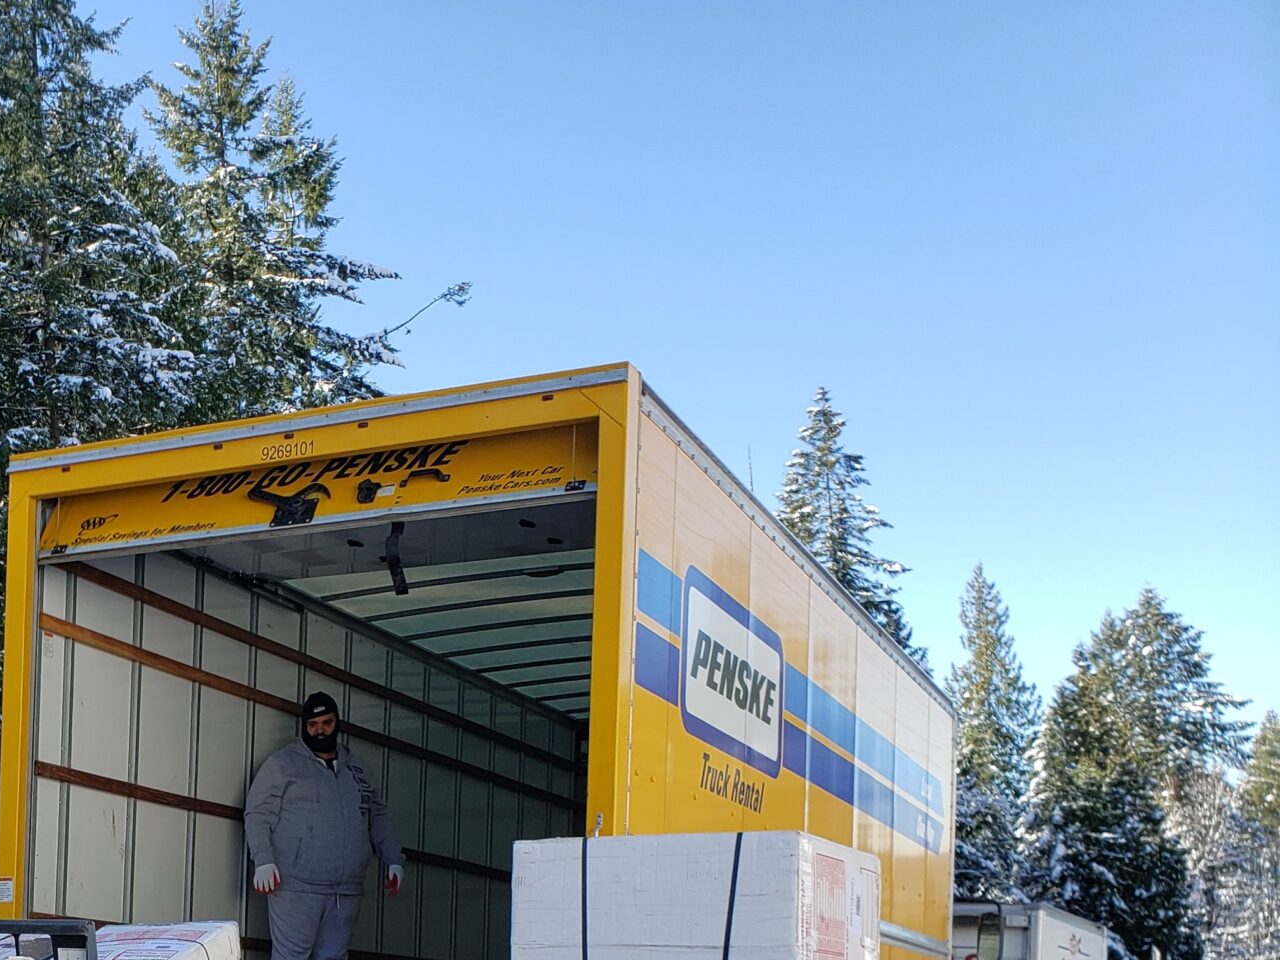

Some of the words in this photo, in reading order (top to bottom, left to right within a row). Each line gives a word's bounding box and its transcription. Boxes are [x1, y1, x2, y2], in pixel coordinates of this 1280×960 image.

[161, 440, 470, 503] 1-800-GO-PENSKE
[260, 440, 315, 461] 9269101
[478, 473, 505, 482] Your
[506, 469, 539, 479] Next
[541, 465, 564, 475] Car
[72, 534, 109, 546] Special
[111, 531, 148, 541] Savings
[151, 528, 168, 536] for
[169, 522, 216, 533] Members
[690, 629, 776, 726] PENSKE
[700, 753, 730, 802] Truck
[731, 767, 764, 814] Rental
